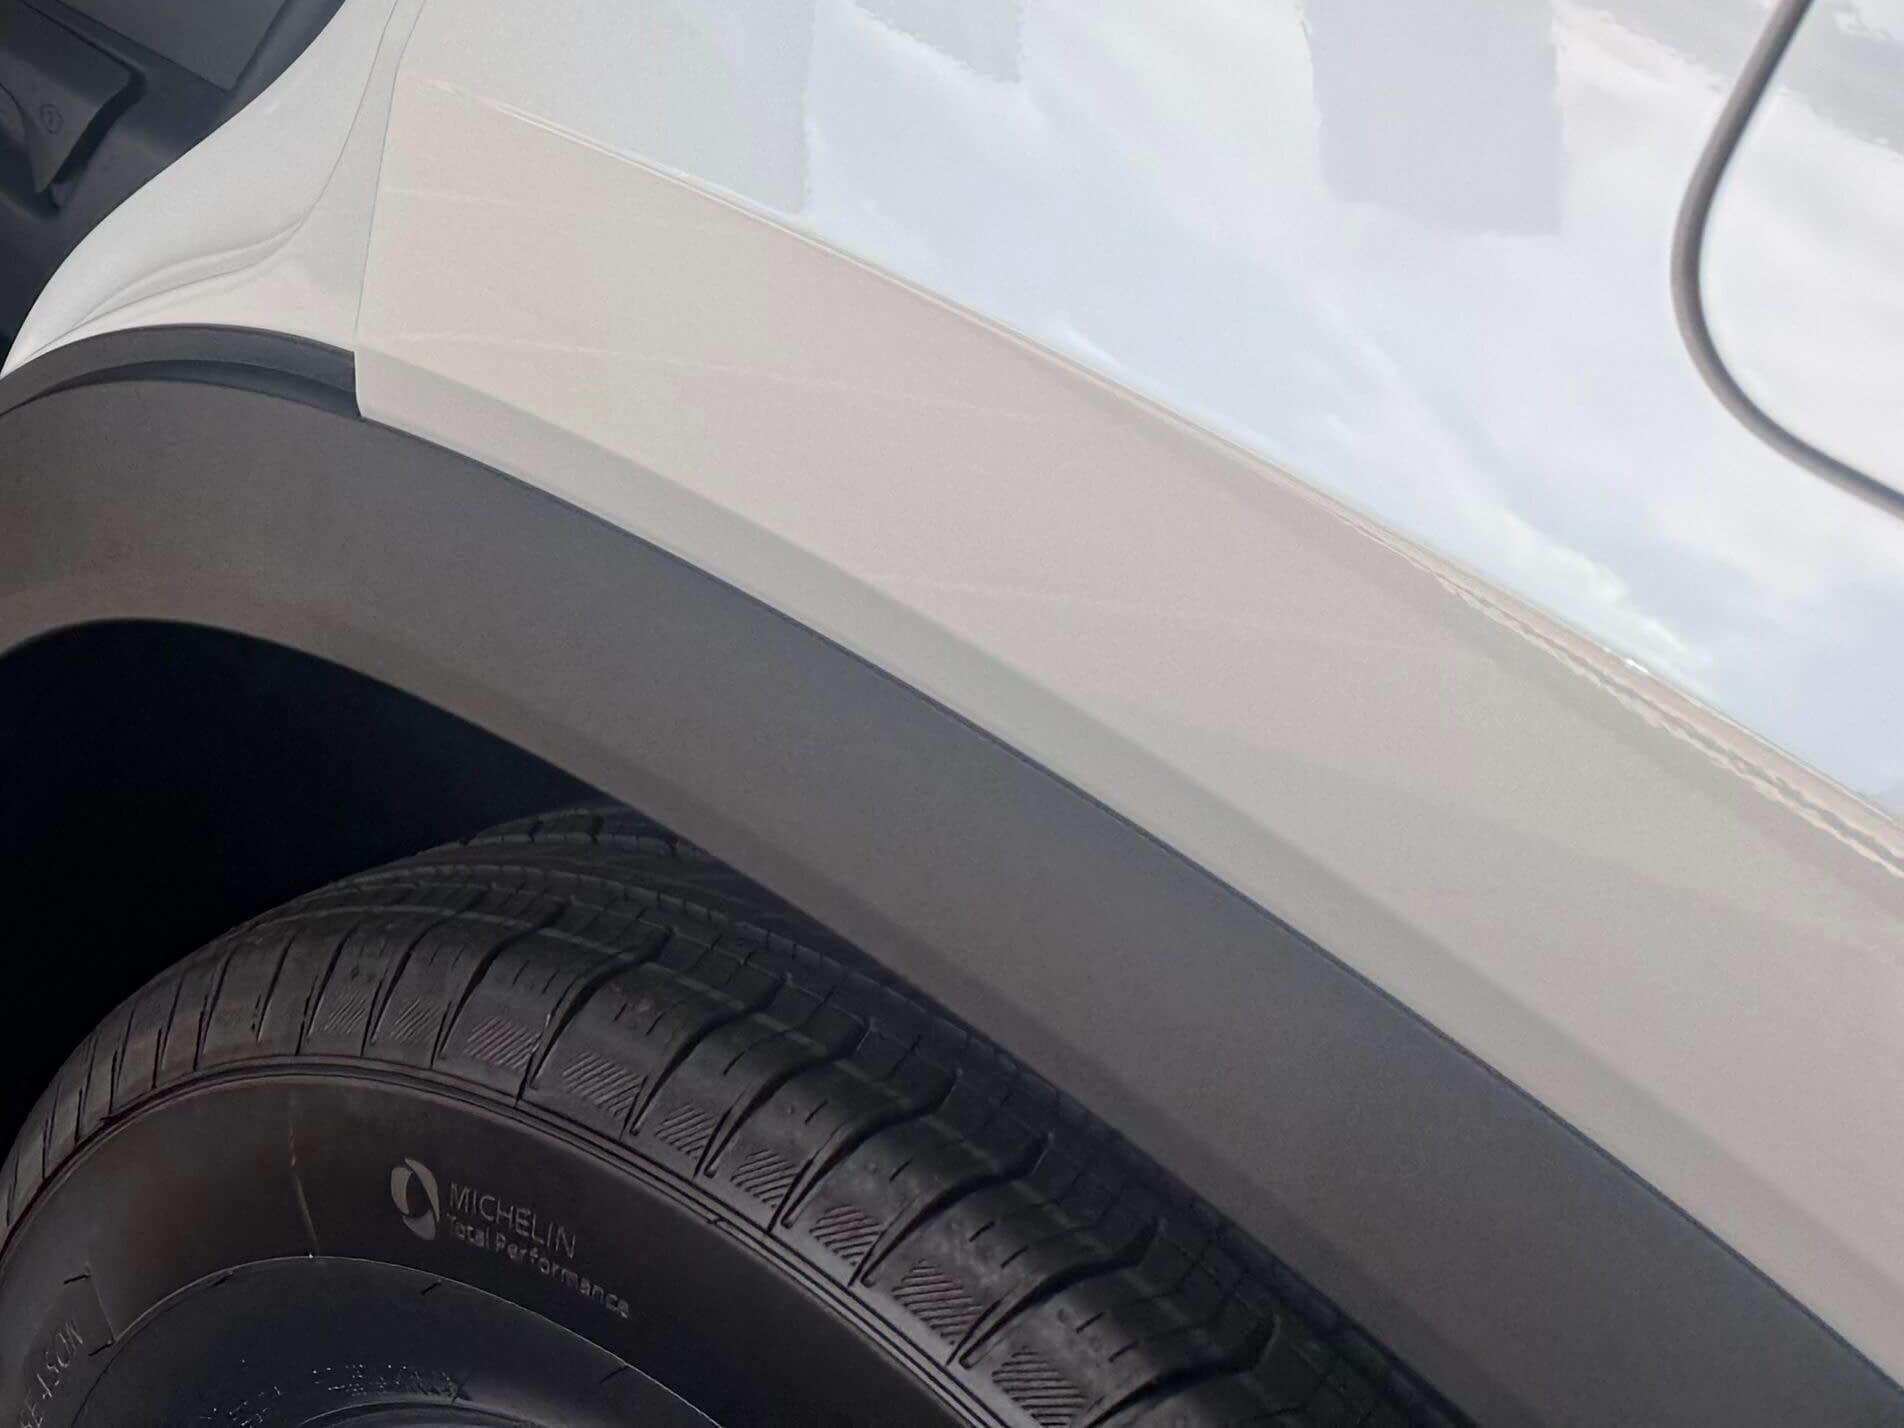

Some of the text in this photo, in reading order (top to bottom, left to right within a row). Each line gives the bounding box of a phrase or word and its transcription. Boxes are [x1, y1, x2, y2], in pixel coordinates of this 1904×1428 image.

[448, 1182, 577, 1260] MICHELIN
[446, 1215, 631, 1320] Total Performance
